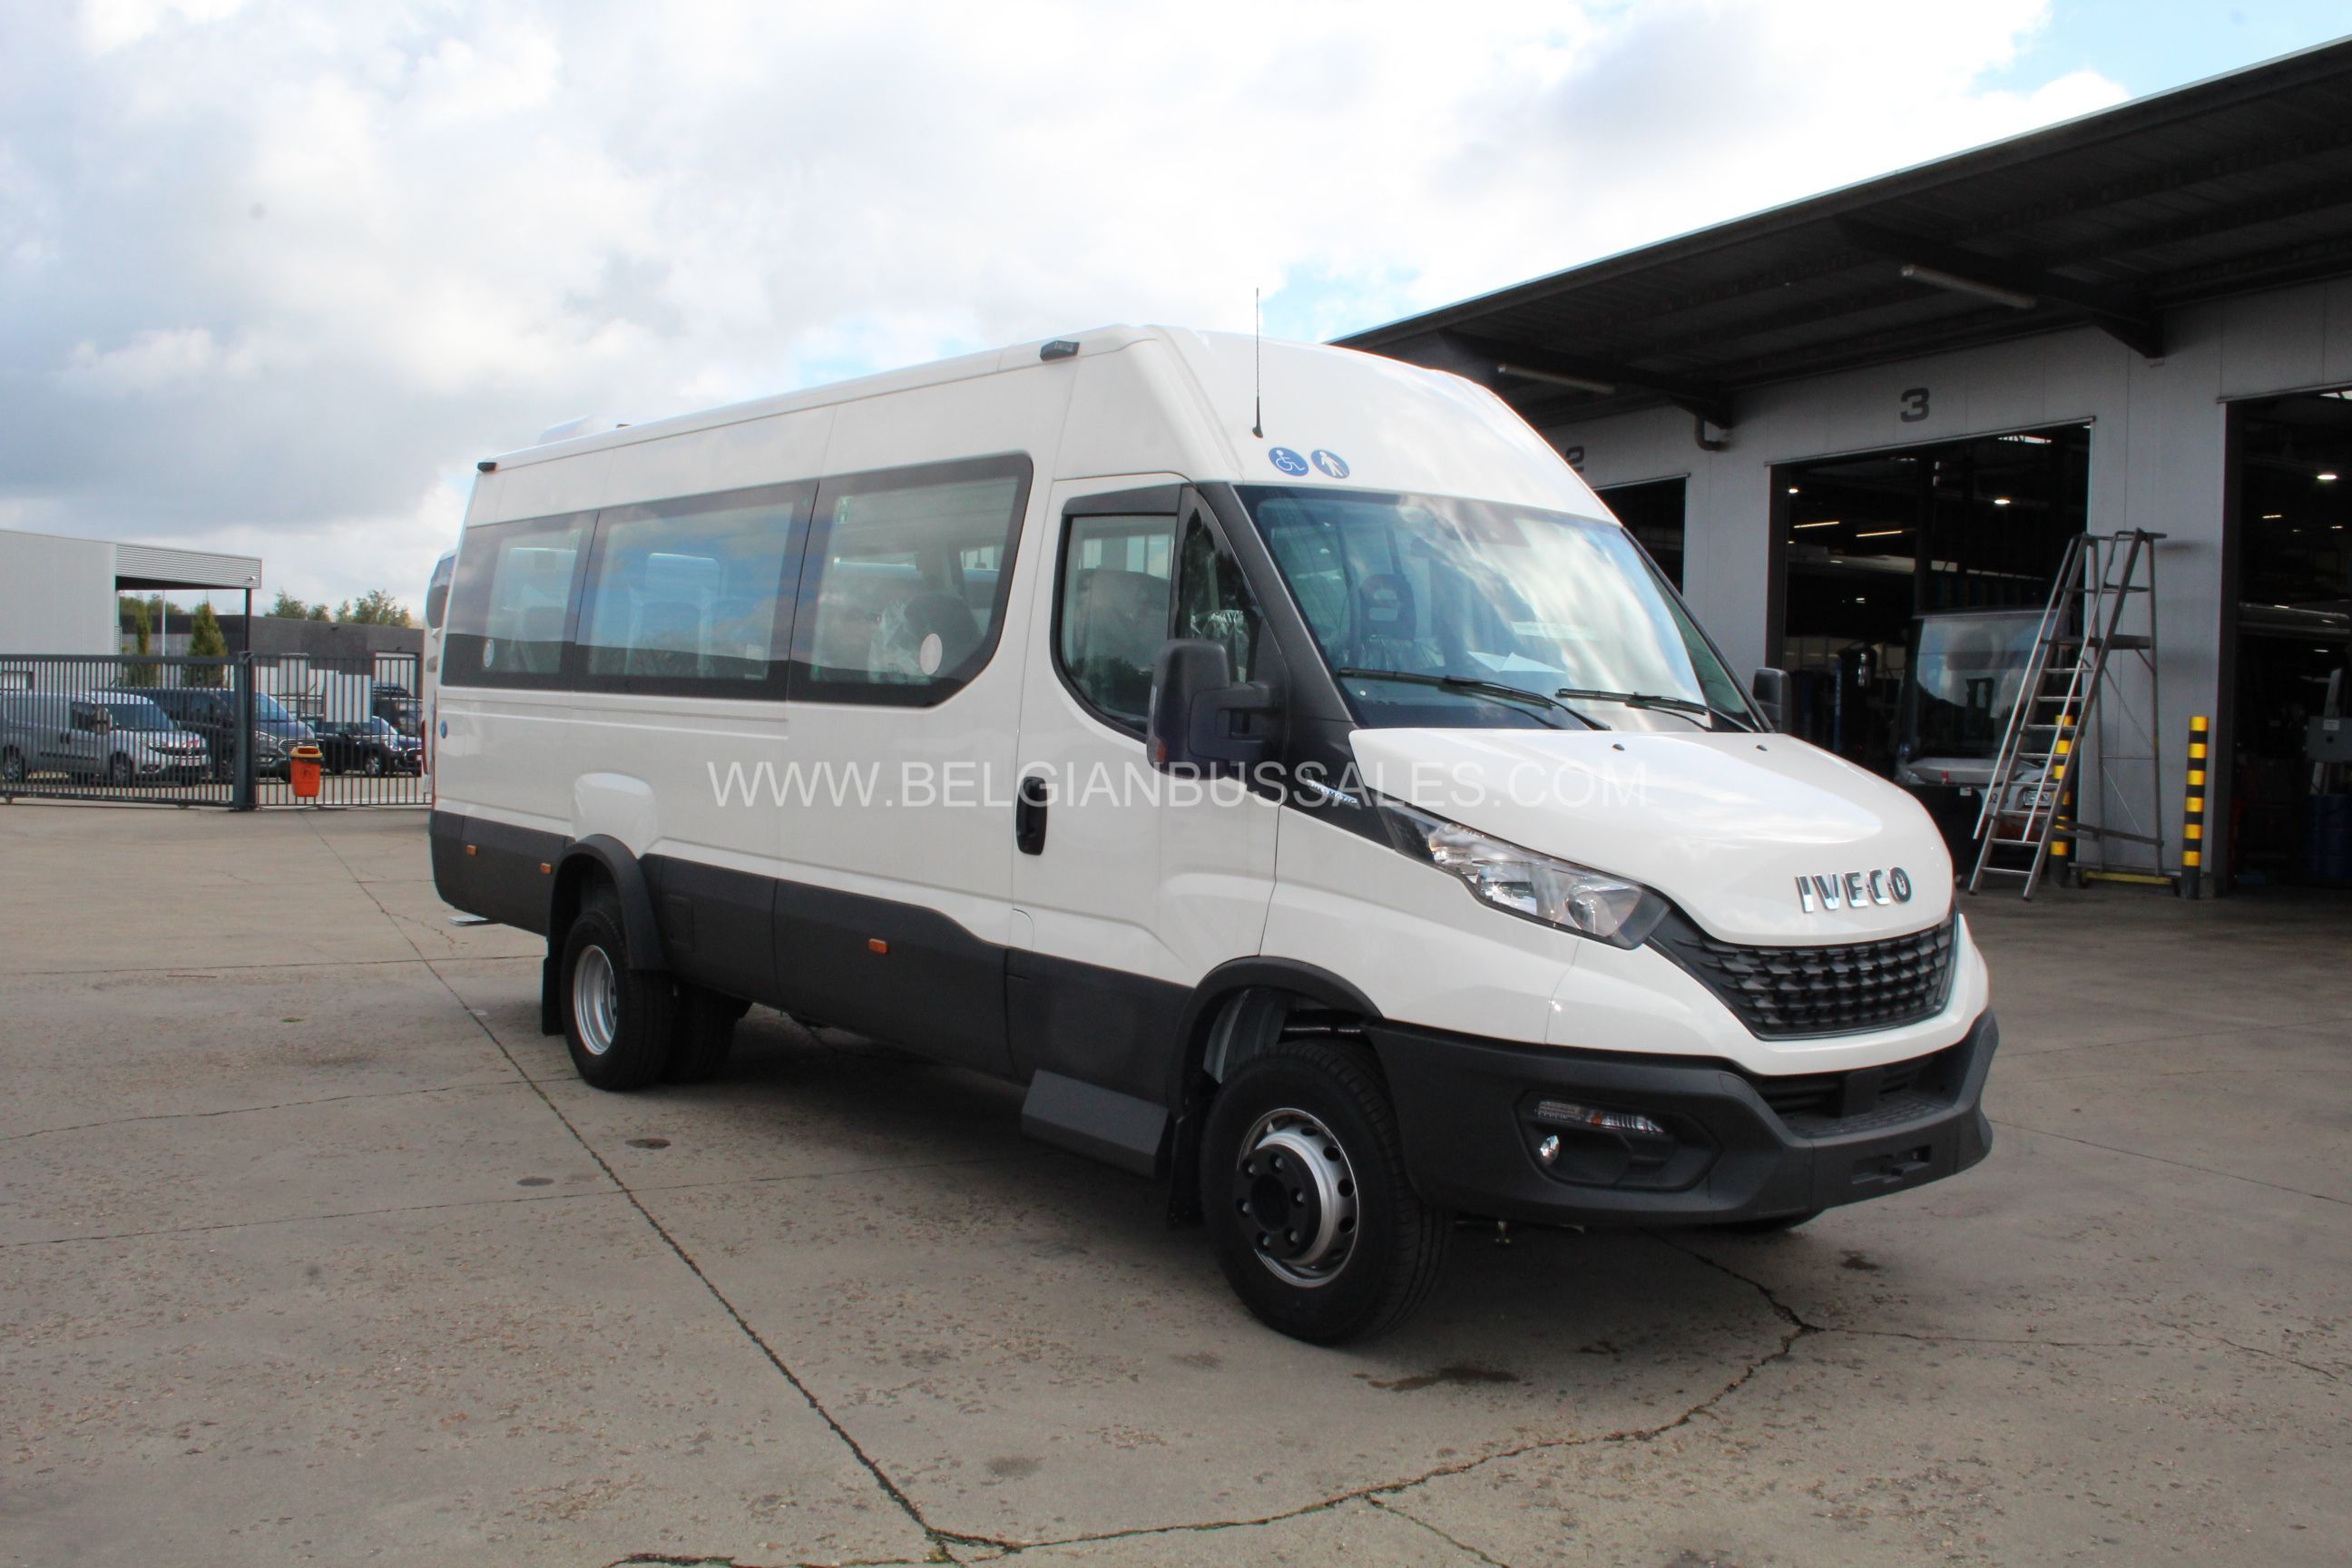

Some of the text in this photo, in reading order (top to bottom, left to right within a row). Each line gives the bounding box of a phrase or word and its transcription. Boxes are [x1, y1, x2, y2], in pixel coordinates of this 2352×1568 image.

[1900, 387, 1929, 422] 3
[1566, 446, 1584, 473] 2
[1795, 867, 1912, 913] IVECO
